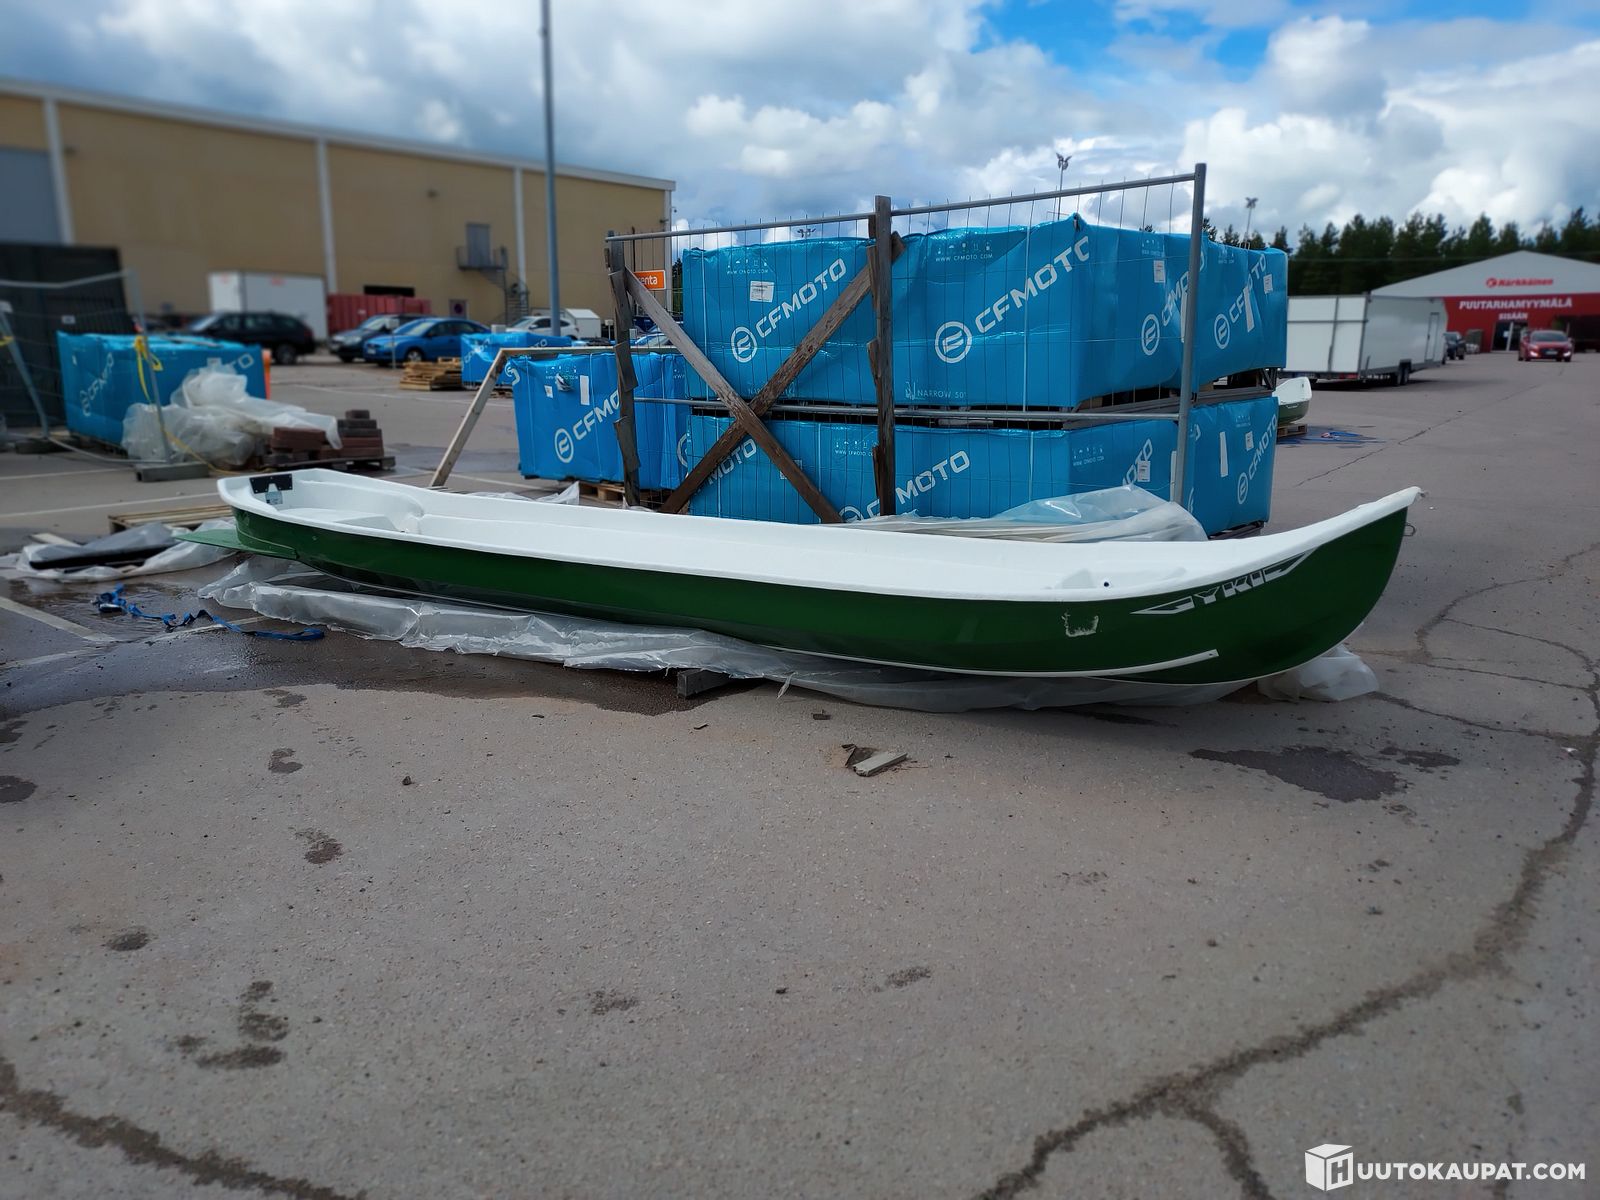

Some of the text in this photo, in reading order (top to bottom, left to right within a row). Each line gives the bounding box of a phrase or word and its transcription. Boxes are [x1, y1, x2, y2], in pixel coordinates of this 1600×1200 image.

[755, 257, 847, 338] CFMOTO
[572, 389, 620, 441] CFMO
[707, 438, 757, 486] MOTO
